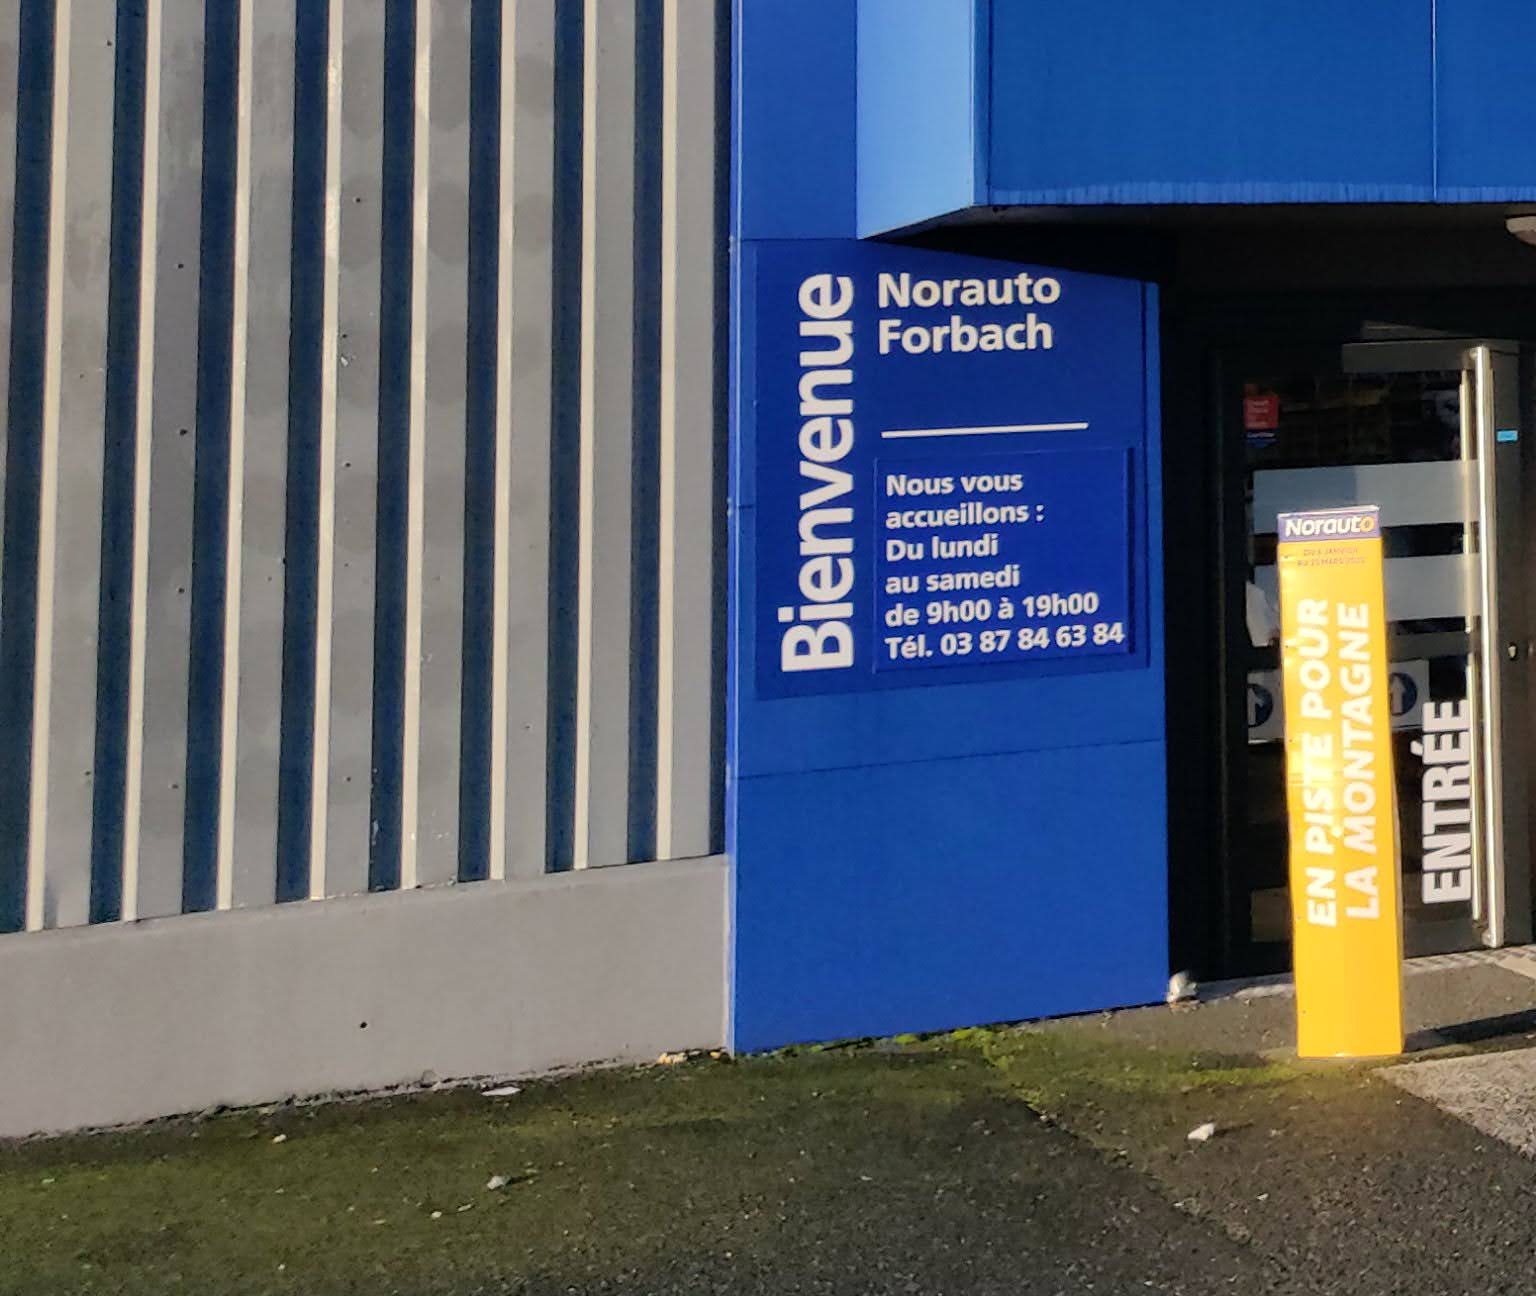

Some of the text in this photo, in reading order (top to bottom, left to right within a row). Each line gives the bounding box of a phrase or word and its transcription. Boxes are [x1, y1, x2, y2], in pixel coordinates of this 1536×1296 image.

[878, 273, 1061, 308] Norauto
[879, 313, 1053, 354] Forbach
[778, 273, 854, 672] Bienvenue
[886, 473, 1024, 496] Nous vous
[885, 502, 1029, 529] accueillons
[1285, 515, 1375, 537] Norauto
[886, 533, 999, 562] Du lundi
[885, 564, 1020, 594] au samedi
[885, 591, 1100, 627] de 9h00 à 19h00
[884, 622, 1126, 661] Tél. 03 87 84 63 84
[1337, 602, 1379, 856] MONTAGNE
[1299, 599, 1338, 928] EN PISTE POUR
[1410, 698, 1472, 905] ENTRÉE
[1346, 866, 1380, 921] LA
